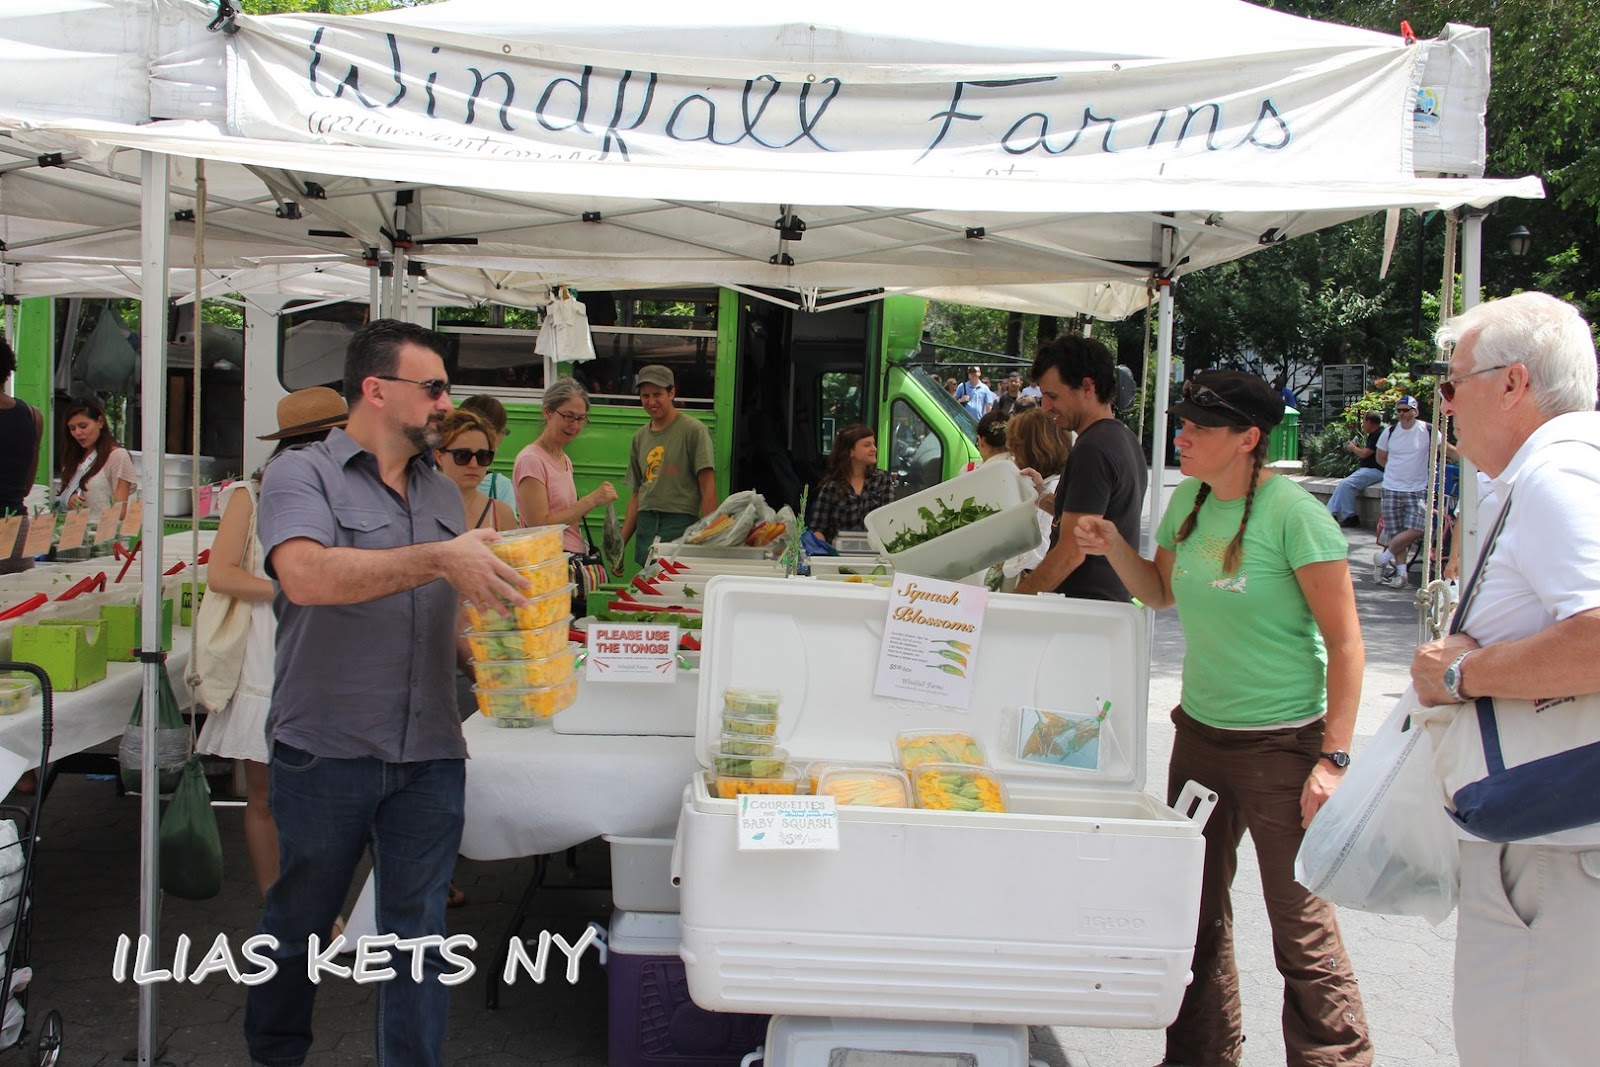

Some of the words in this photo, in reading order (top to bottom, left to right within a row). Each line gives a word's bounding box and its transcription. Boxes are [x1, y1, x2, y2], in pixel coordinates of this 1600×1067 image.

[308, 27, 842, 162] Windfall
[912, 75, 1291, 165] Farms
[897, 582, 960, 606] Squash
[892, 606, 976, 634] Blossoms
[596, 629, 643, 641] PLEASE
[645, 630, 670, 641] USE
[596, 643, 620, 654] THE
[622, 643, 669, 654] TONGS!
[750, 800, 826, 810] COURGETTES
[742, 818, 774, 829] BABY
[781, 818, 833, 831] SQUASH
